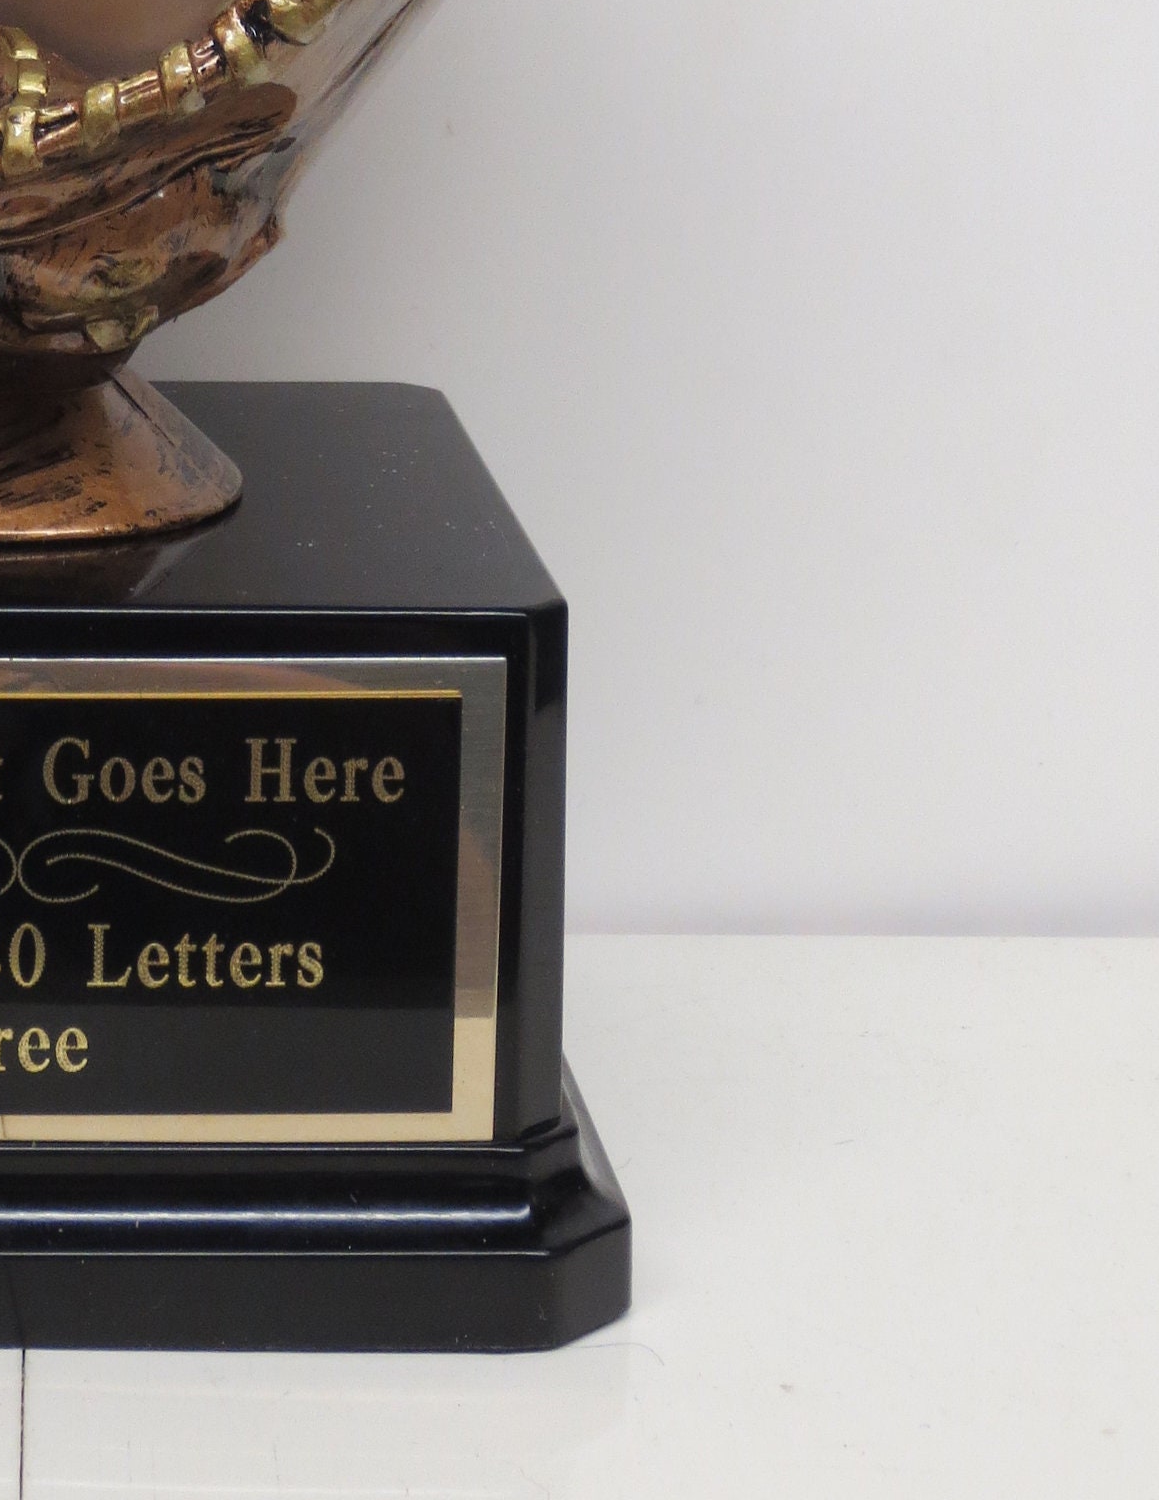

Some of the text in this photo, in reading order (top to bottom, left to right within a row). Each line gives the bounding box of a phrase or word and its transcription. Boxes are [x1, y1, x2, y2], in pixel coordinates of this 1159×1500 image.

[42, 737, 207, 804] Goes
[244, 738, 405, 803] Here
[86, 924, 324, 989] Letters
